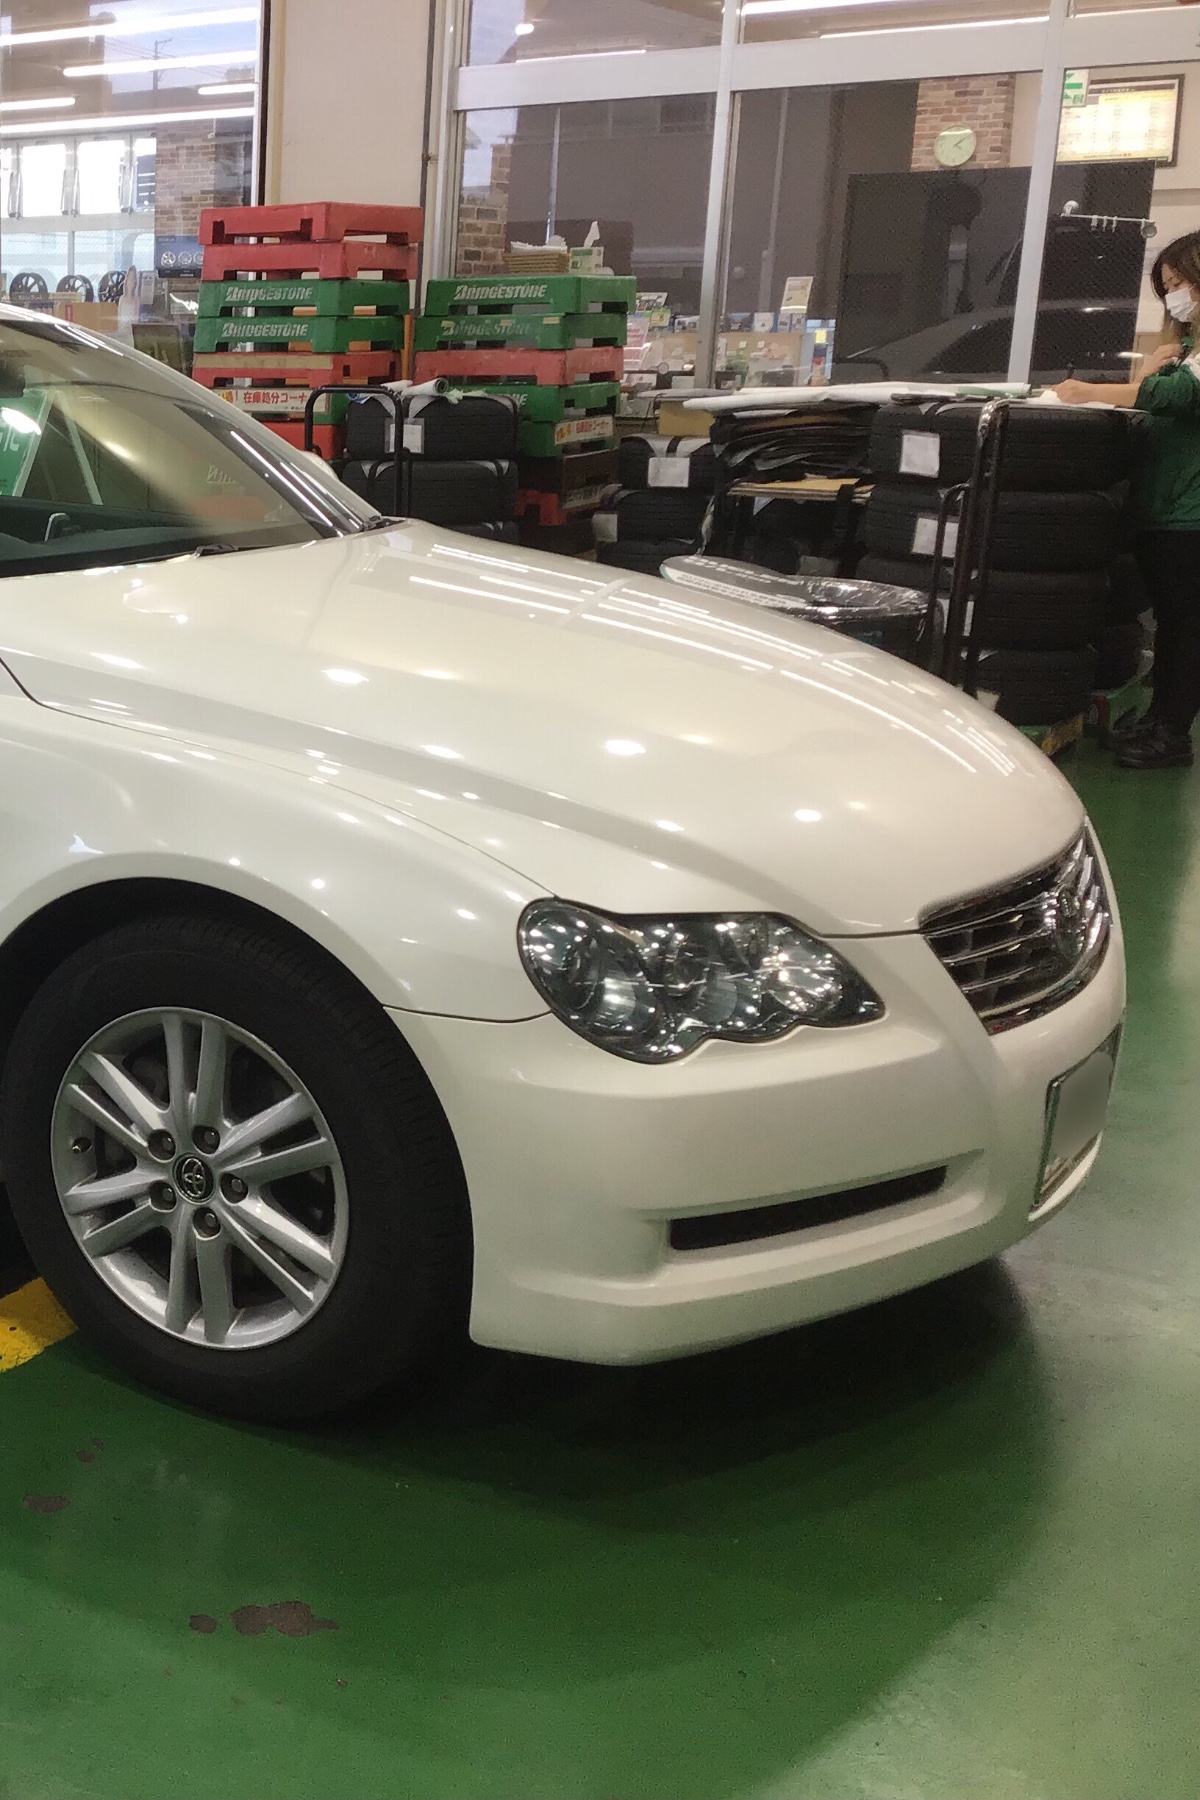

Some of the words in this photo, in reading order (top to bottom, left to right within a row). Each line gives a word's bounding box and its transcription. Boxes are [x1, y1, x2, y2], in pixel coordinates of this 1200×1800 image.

[225, 286, 314, 302] BRIDGESTONE
[454, 284, 548, 300] BRIDGESTONE
[221, 322, 309, 338] BRIDGESTONE
[243, 391, 308, 404] 在庫処分コーナ
